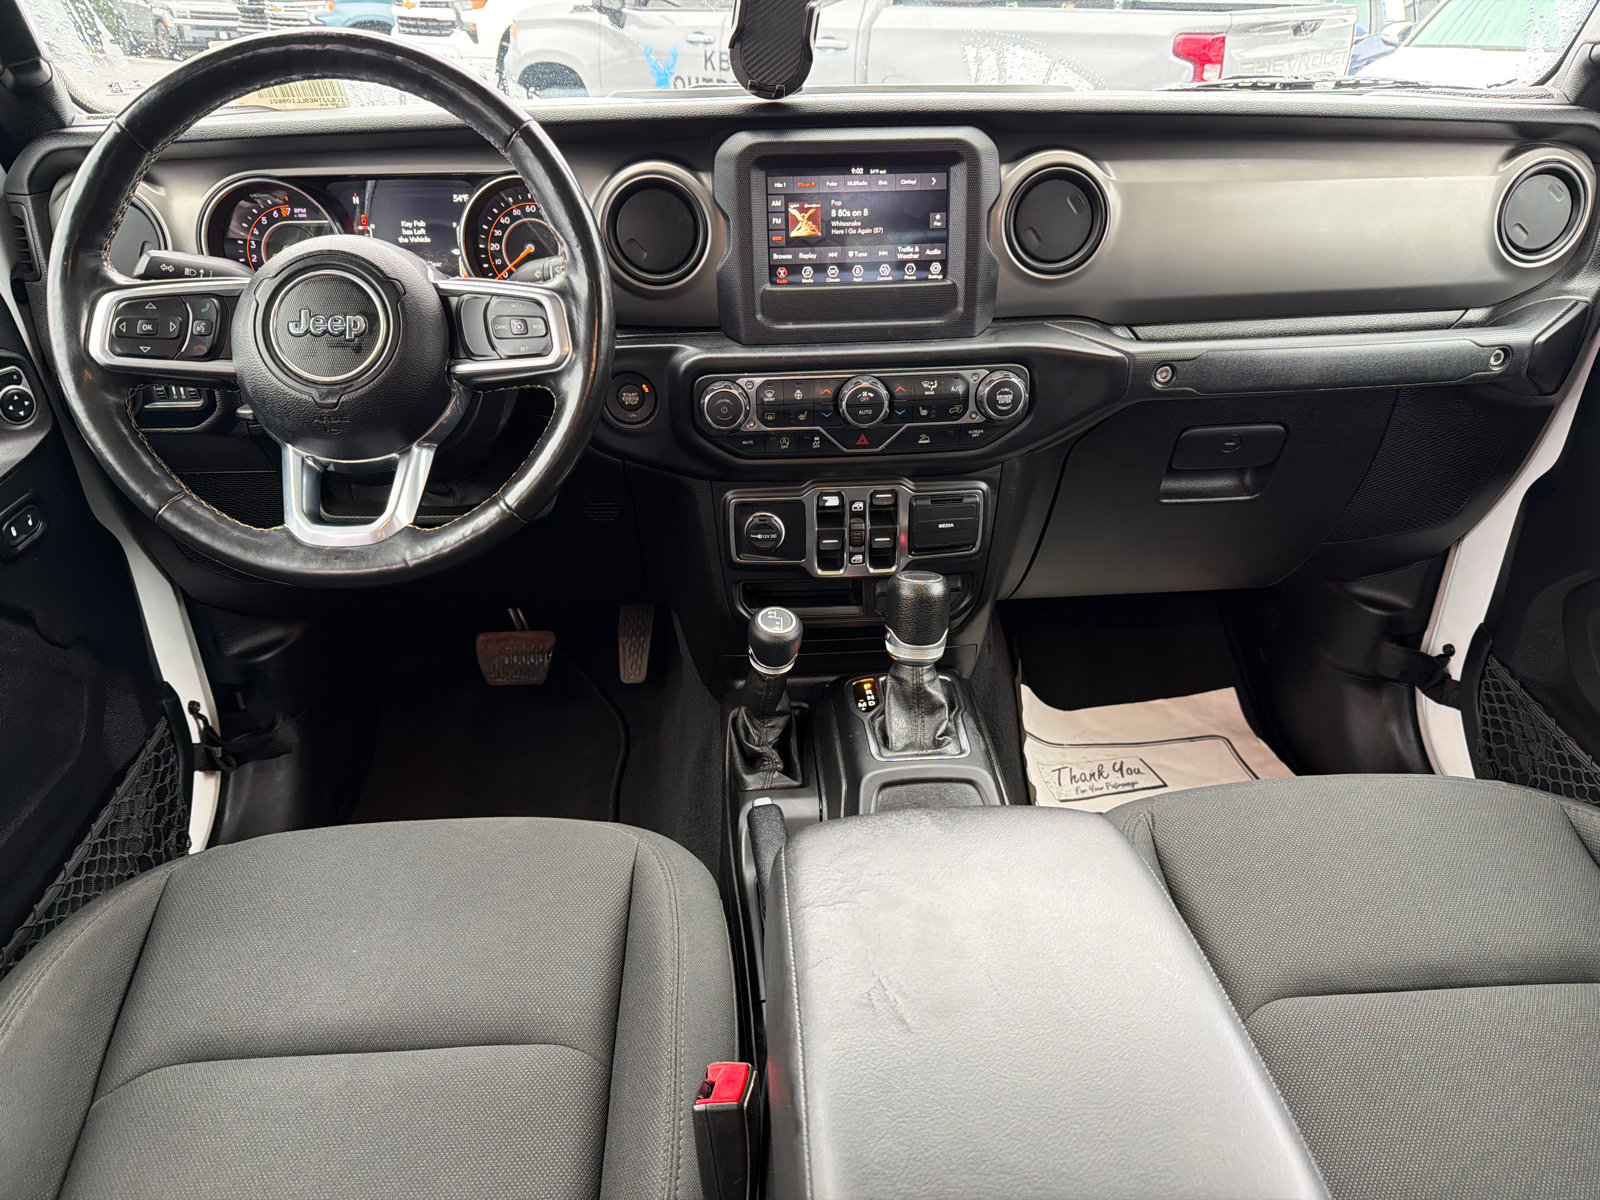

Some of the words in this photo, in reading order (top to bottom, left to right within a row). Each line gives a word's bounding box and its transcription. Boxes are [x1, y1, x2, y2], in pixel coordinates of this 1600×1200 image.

[851, 167, 864, 175] 9:02
[352, 196, 360, 205] N
[525, 205, 536, 213] 60
[838, 209, 851, 217] 80s
[863, 208, 869, 216] 8
[273, 210, 279, 218] 6
[261, 217, 268, 225] 5
[401, 220, 412, 228] Key
[500, 217, 511, 225] 40
[253, 228, 259, 236] 4
[250, 240, 256, 249] 3
[490, 243, 500, 251] 20
[251, 254, 257, 263] 2
[799, 252, 817, 260] Replay
[142, 322, 153, 331] OK
[288, 309, 368, 342] Jeep
[858, 701, 867, 709] M
[1051, 763, 1110, 787] Thank
[1112, 760, 1145, 778] You
